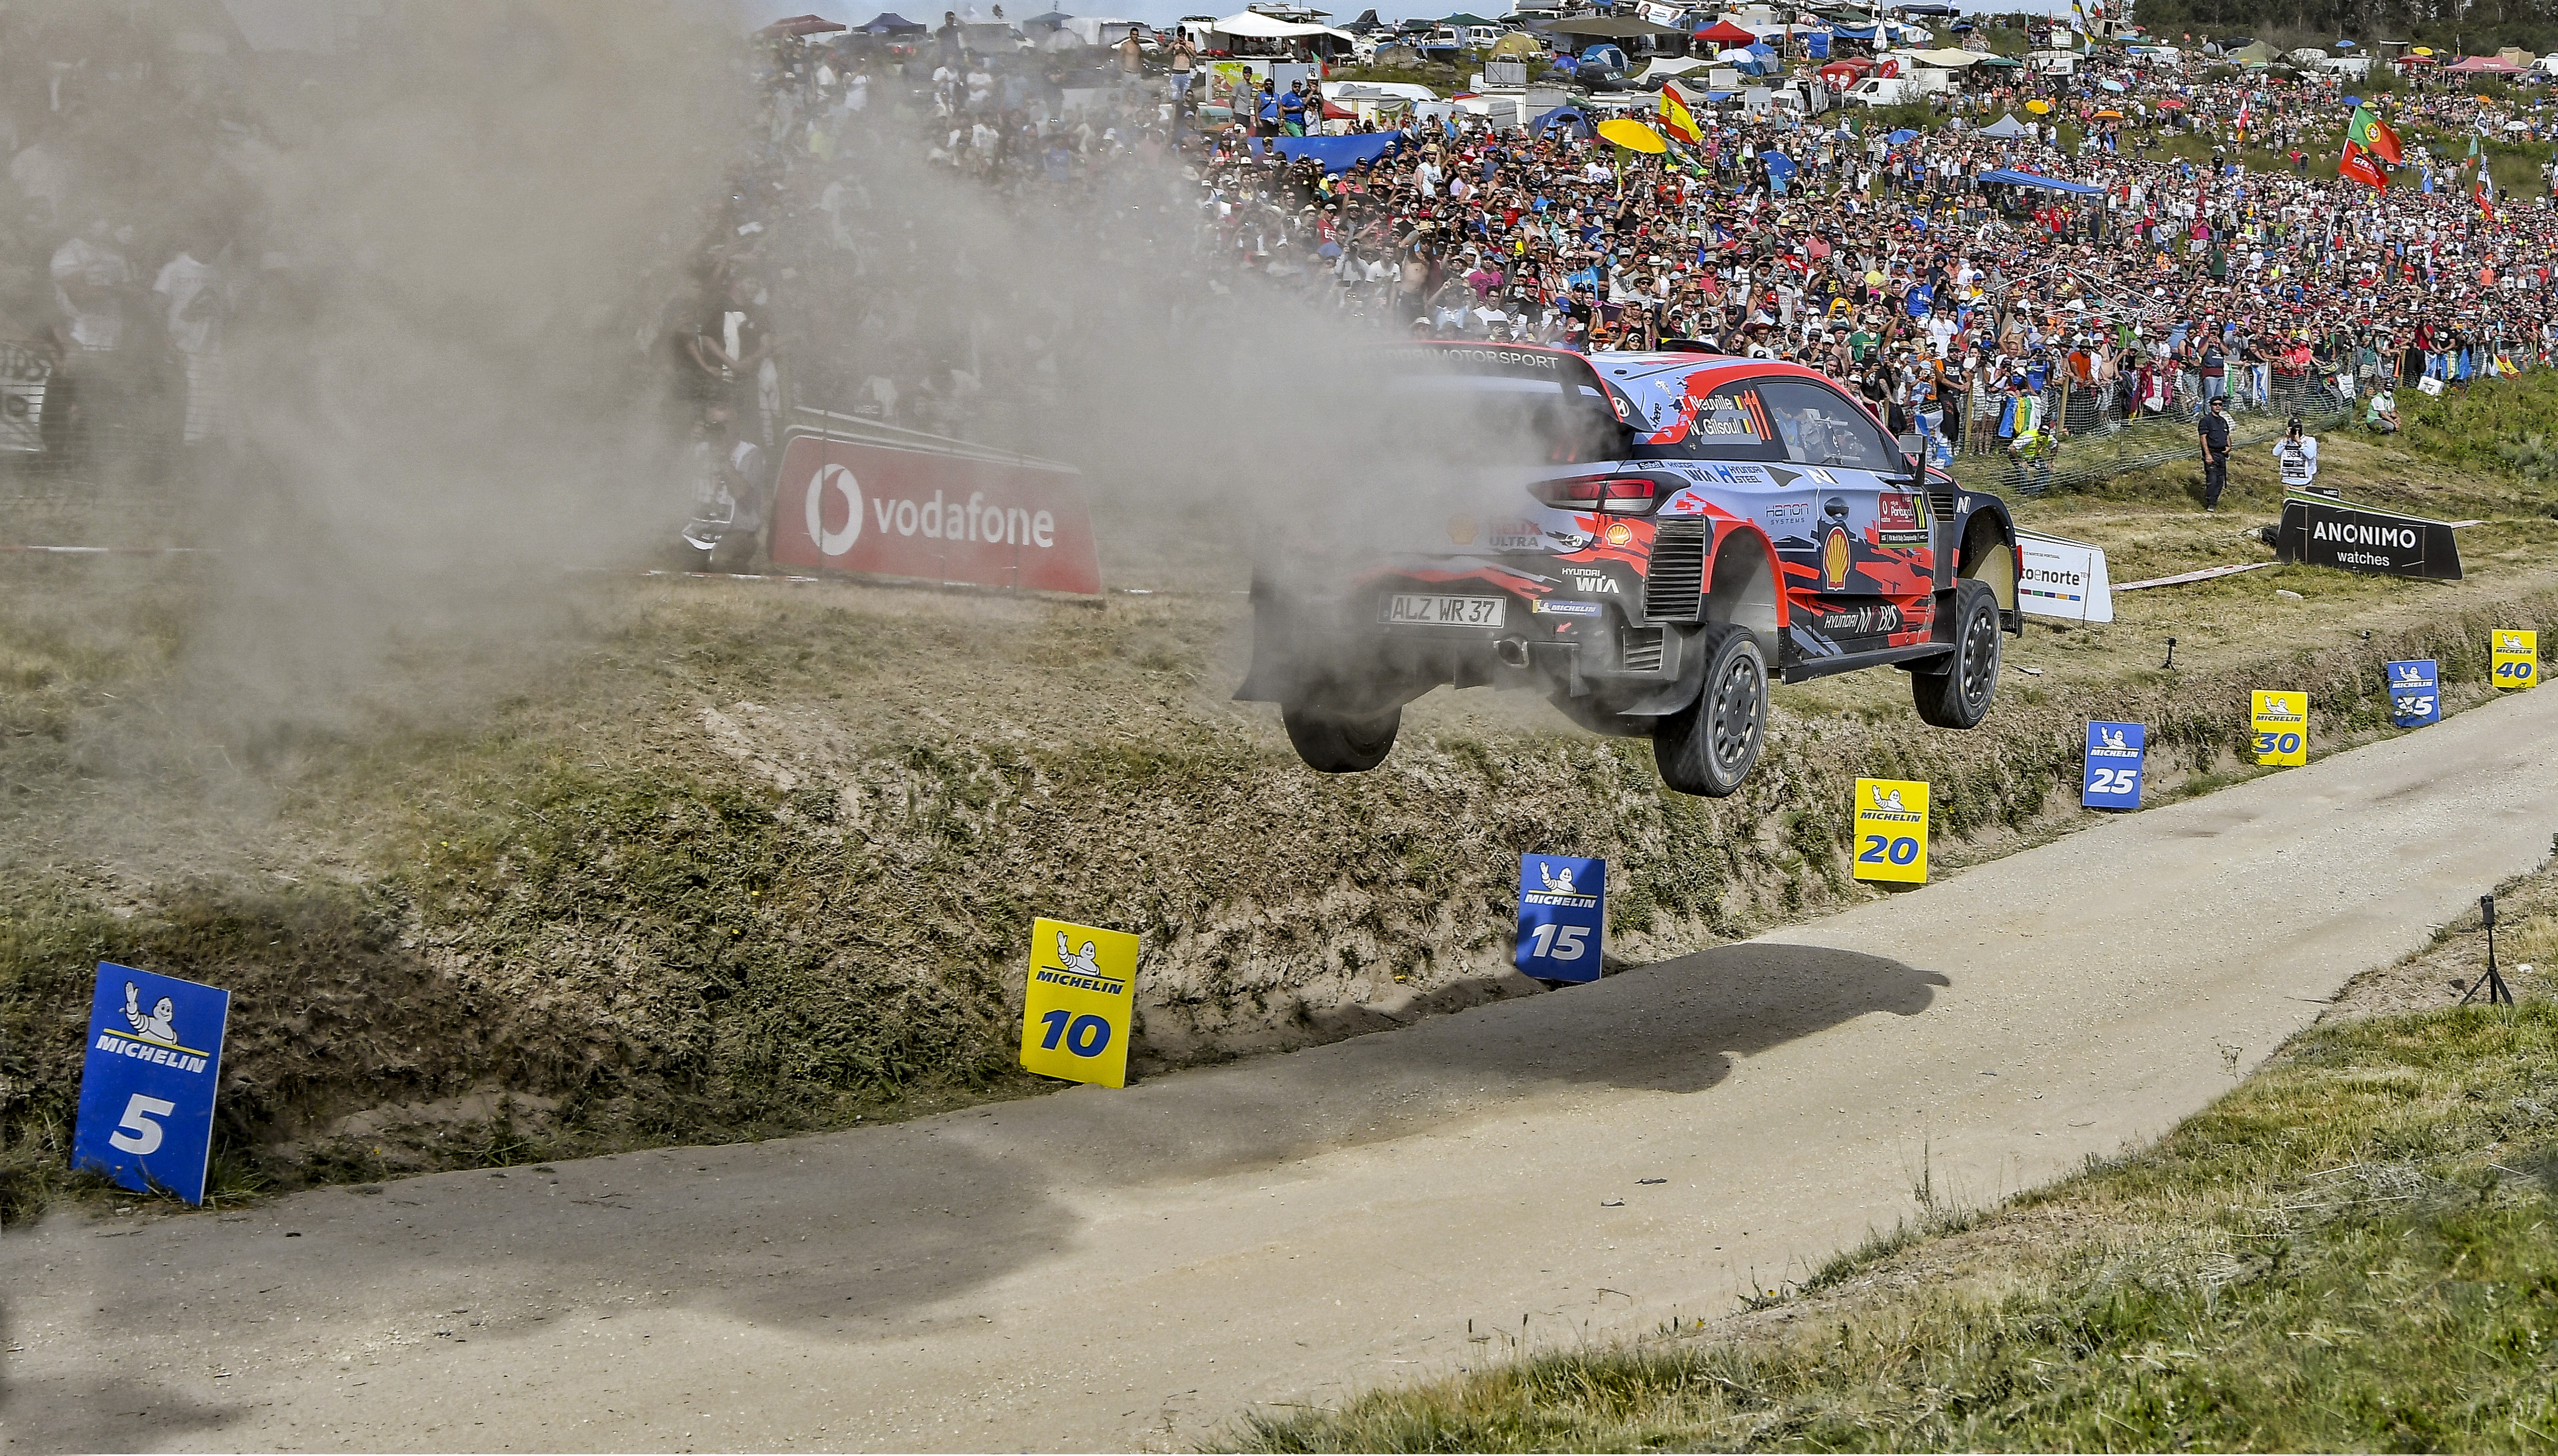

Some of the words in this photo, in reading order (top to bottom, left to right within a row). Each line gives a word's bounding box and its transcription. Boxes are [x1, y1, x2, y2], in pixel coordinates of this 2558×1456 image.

[1433, 350, 1559, 369] MOTORSPORT
[1677, 396, 1690, 411] T.
[1691, 394, 1733, 411] Neuville
[1651, 402, 1662, 424] here
[1743, 389, 1772, 440] 11
[1688, 419, 1703, 436] N.
[1704, 418, 1741, 435] Gilsoul
[1729, 465, 1763, 474] HYUNDAI
[1735, 475, 1763, 484] STEEL
[873, 489, 1054, 548] vodafone
[1891, 506, 1913, 519] Portugal
[1914, 496, 1925, 529] 11
[1489, 535, 1538, 547] ULTRA
[2313, 521, 2416, 549] ANONIMO
[2337, 551, 2390, 567] watches
[1562, 567, 1601, 577] HYUNDAI
[1392, 597, 1432, 620] ALZ
[1439, 598, 1465, 622] WR
[1468, 600, 1496, 623] 37
[1551, 604, 1597, 613] MICHELIN
[1824, 614, 1859, 629] HYUNDAI
[1855, 604, 1898, 633] MOBIS
[2495, 662, 2532, 679] 40
[2394, 696, 2435, 716] 35
[2090, 749, 2140, 758] MICHELIN
[2255, 733, 2300, 754] 30
[2087, 768, 2138, 794] 25
[1860, 812, 1921, 822] MICHELIN
[1858, 835, 1919, 866] 20
[1524, 893, 1596, 909] MICHELIN
[1531, 923, 1591, 961] 15
[1035, 970, 1124, 995] MICHELIN
[1040, 1009, 1112, 1058] 10
[95, 1034, 207, 1074] MICHELIN
[108, 1092, 176, 1155] 5
